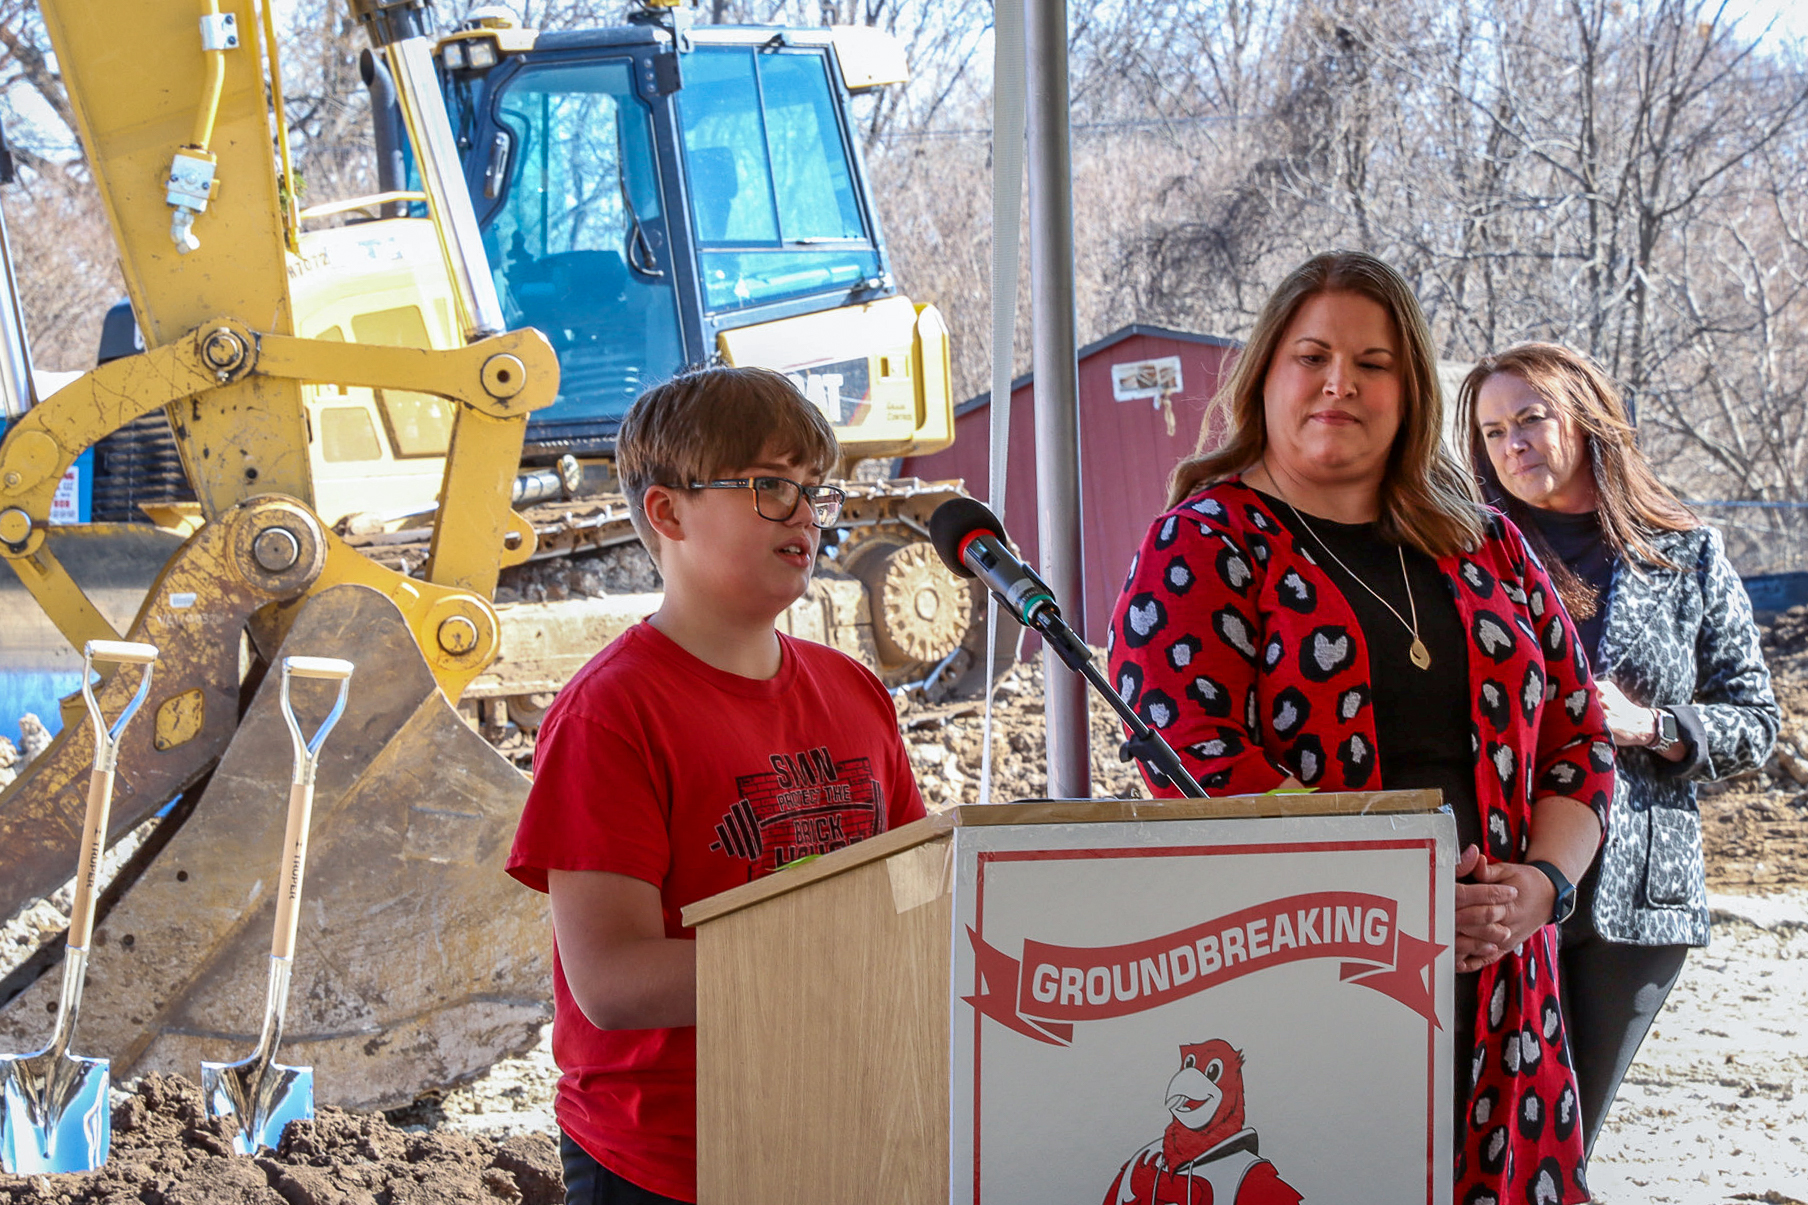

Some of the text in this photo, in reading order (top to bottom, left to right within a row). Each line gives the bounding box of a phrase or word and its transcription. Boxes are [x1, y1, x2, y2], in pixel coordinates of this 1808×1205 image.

[769, 746, 838, 789] SMN
[823, 784, 852, 803] THE
[793, 813, 846, 845] BRICK
[1031, 905, 1390, 1006] GROUNDBREAKING
